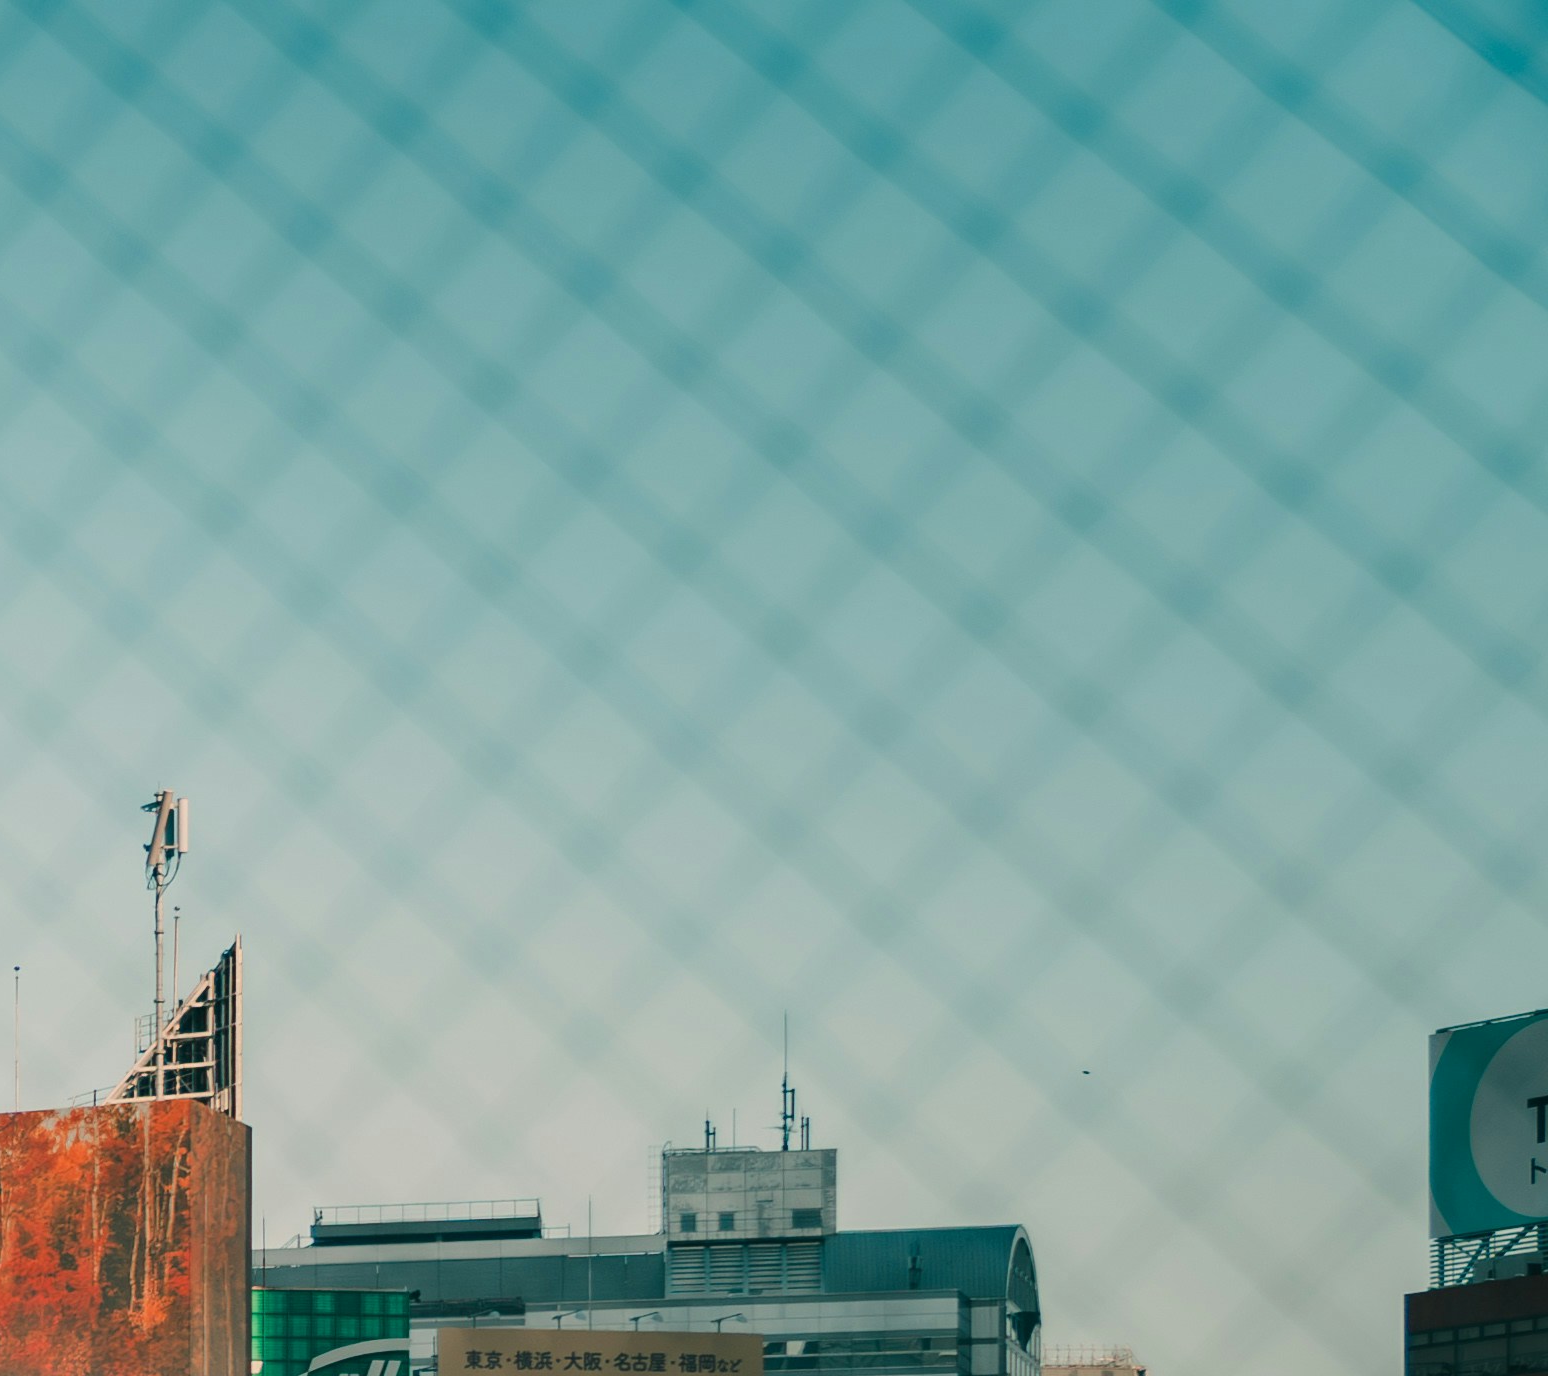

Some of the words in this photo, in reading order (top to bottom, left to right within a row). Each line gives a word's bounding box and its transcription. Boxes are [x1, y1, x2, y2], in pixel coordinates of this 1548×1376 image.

[465, 1351, 742, 1373] 東京・横浜・大阪・名古屋・福岡など
